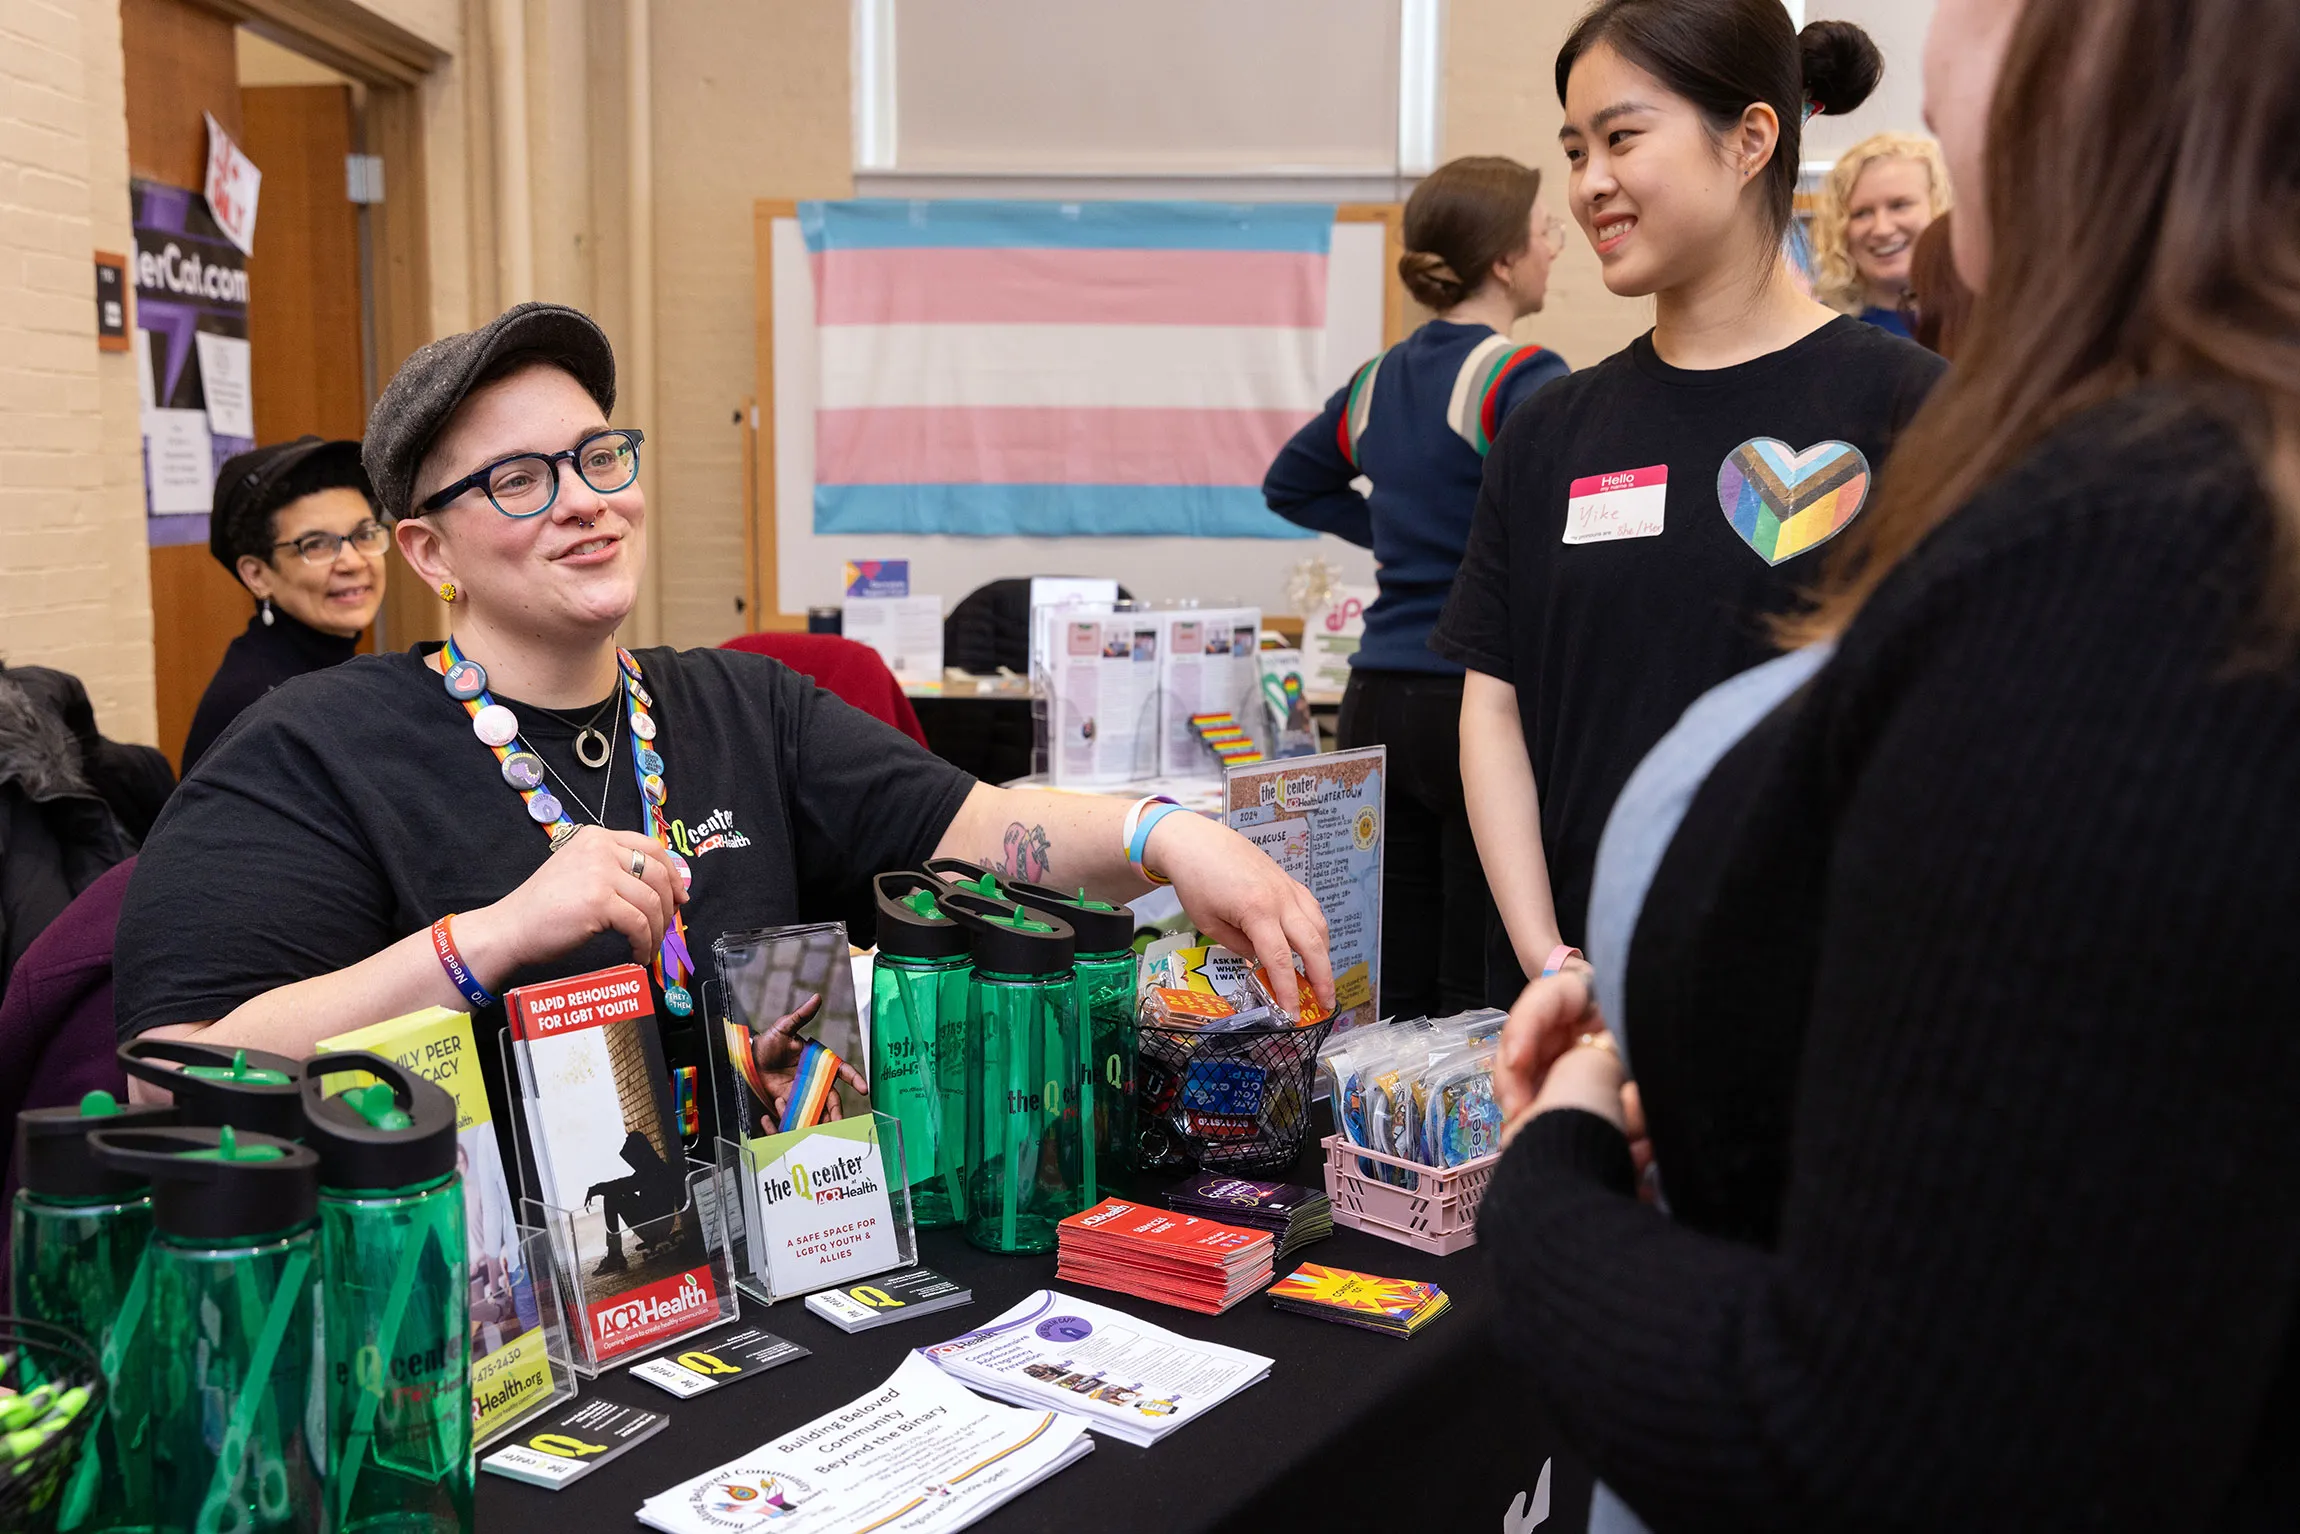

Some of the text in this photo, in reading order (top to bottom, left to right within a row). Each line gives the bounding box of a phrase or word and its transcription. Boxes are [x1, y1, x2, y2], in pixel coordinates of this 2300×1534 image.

[1601, 473, 1635, 487] Hello
[1579, 531, 1602, 540] pronouns
[1261, 785, 1276, 803] the
[1286, 777, 1315, 796] center
[1317, 787, 1363, 805] WATERTOWN
[1239, 810, 1259, 822] 2024
[671, 819, 694, 856] Q
[694, 832, 751, 857] ACRHealth
[434, 928, 450, 955] help?
[443, 954, 468, 985] Need
[530, 980, 641, 1015] RAPID REHOUSING
[538, 998, 639, 1031] FOR LGBT YOUTH
[426, 1036, 462, 1062] PEER
[1008, 1089, 1040, 1115] the
[1043, 1080, 1060, 1116] Q
[764, 1156, 862, 1205] the Q center
[816, 1180, 878, 1206] ACRHealth
[796, 1232, 821, 1245] SAFE
[823, 1223, 854, 1238] SPACE
[857, 1217, 876, 1229] FOR
[796, 1243, 827, 1258] LGBTQ
[829, 1234, 862, 1249] YOUTH
[820, 1249, 852, 1264] ALLIES
[850, 1286, 906, 1307] Q
[597, 1283, 708, 1341] ACRHealth
[604, 1337, 625, 1350] Opening
[624, 1332, 639, 1342] doors
[645, 1324, 661, 1335] create
[660, 1317, 679, 1330] healthy
[679, 1308, 709, 1323] communities
[677, 1352, 742, 1375] Q
[778, 1421, 846, 1454] Building
[839, 1387, 900, 1422] Beloved
[818, 1409, 904, 1454] Community
[529, 1434, 609, 1458] Q
[814, 1443, 875, 1474] Beyond
[873, 1431, 900, 1446] the
[898, 1405, 948, 1433] Binary
